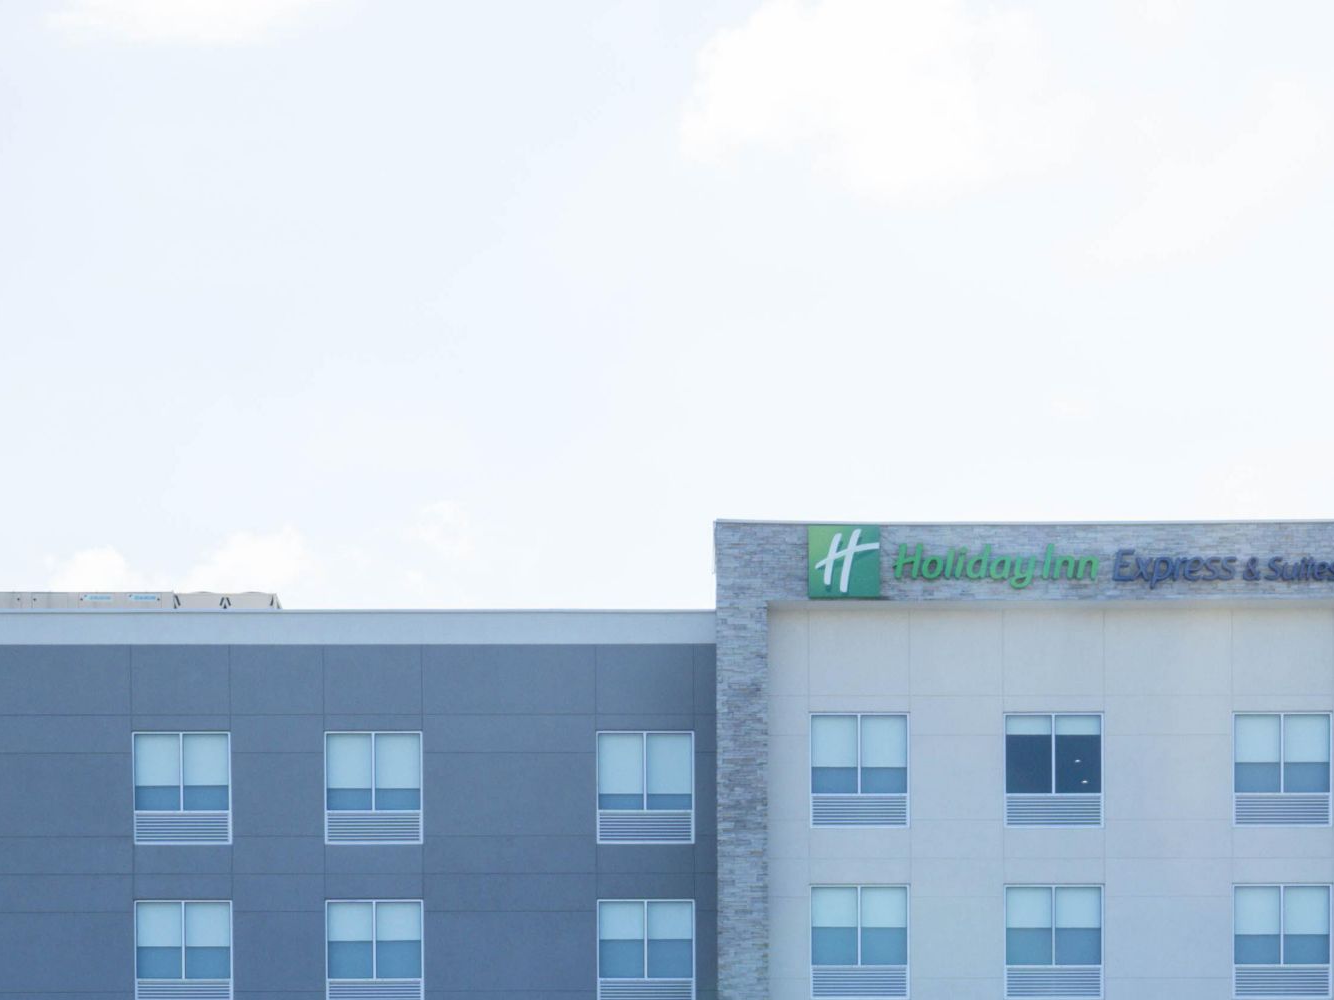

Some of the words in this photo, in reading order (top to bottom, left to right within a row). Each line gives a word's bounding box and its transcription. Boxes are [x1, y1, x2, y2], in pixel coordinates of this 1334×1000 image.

[893, 543, 1036, 590] Holiday
[1041, 543, 1101, 581] Inn
[1112, 549, 1238, 590] Express
[1242, 556, 1261, 582] &
